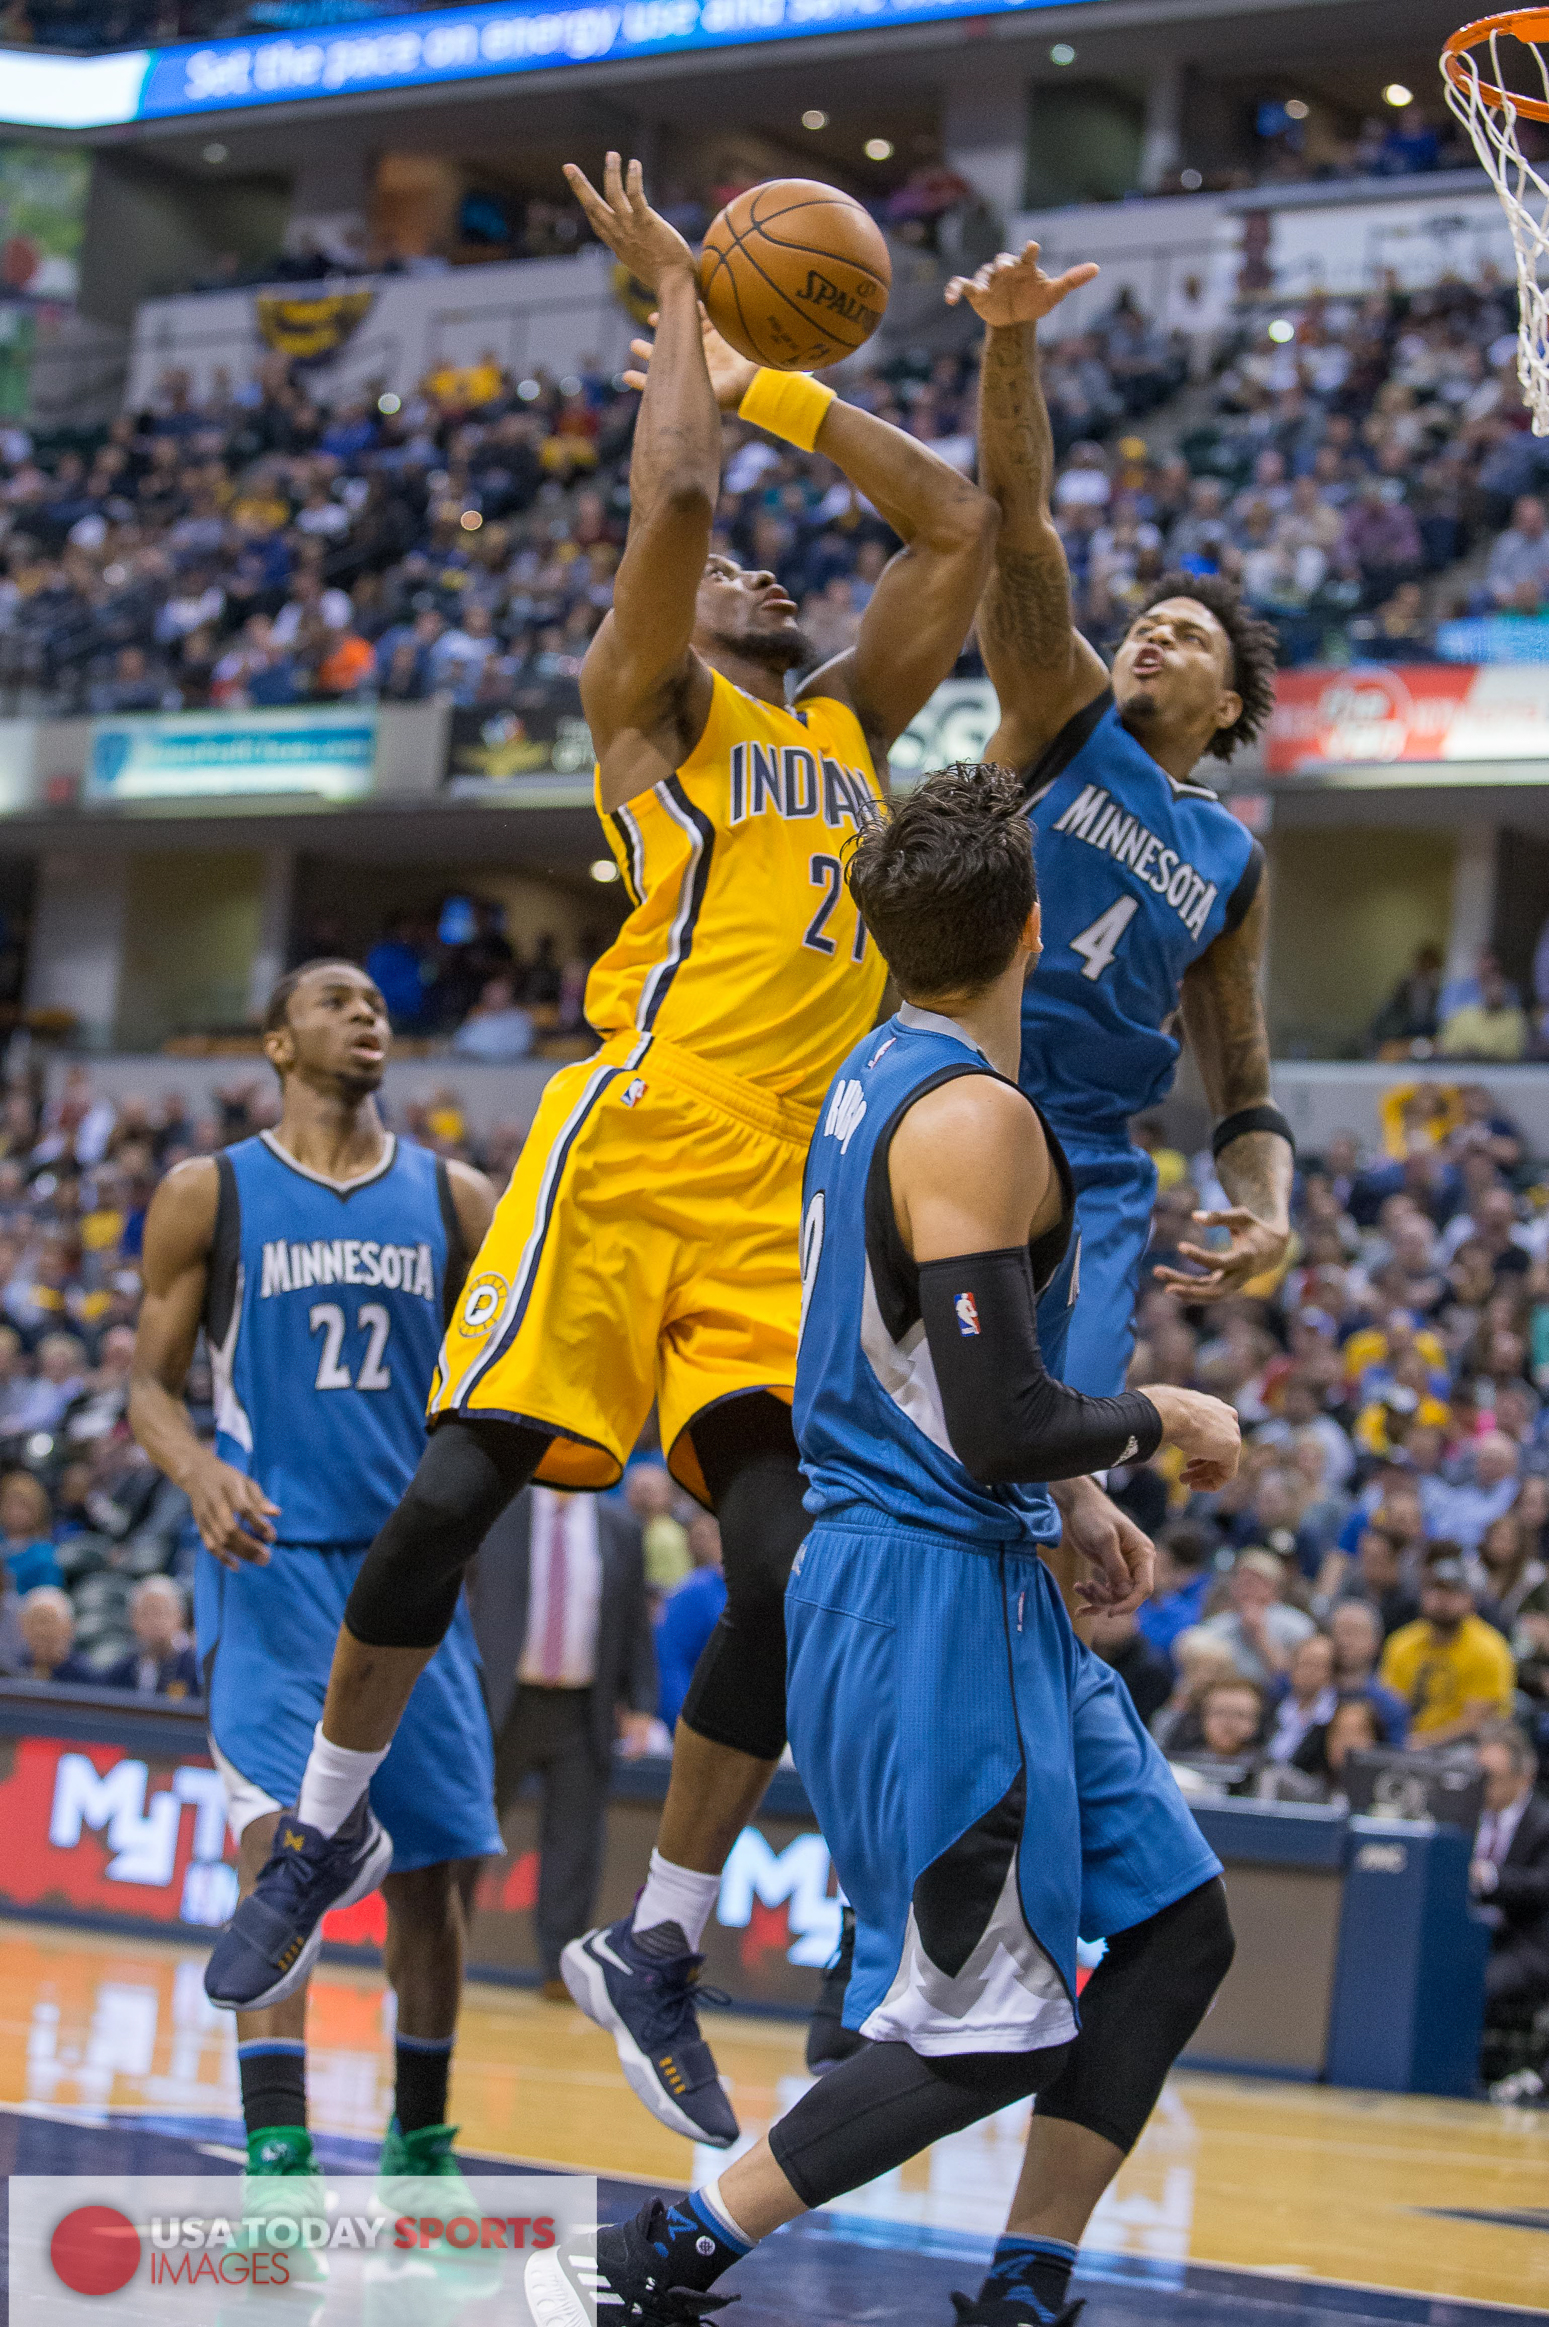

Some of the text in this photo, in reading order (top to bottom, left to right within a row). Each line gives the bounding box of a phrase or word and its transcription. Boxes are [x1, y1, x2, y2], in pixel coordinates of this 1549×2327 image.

[184, 50, 250, 99] Set
[253, 39, 323, 91] the
[321, 32, 422, 90] pace
[423, 24, 479, 69] on
[481, 7, 622, 60] energy
[1052, 783, 1219, 943] MINNESOTA
[1069, 894, 1139, 981] 4
[260, 1238, 434, 1301] MINNESOTA
[309, 1302, 391, 1390] 22
